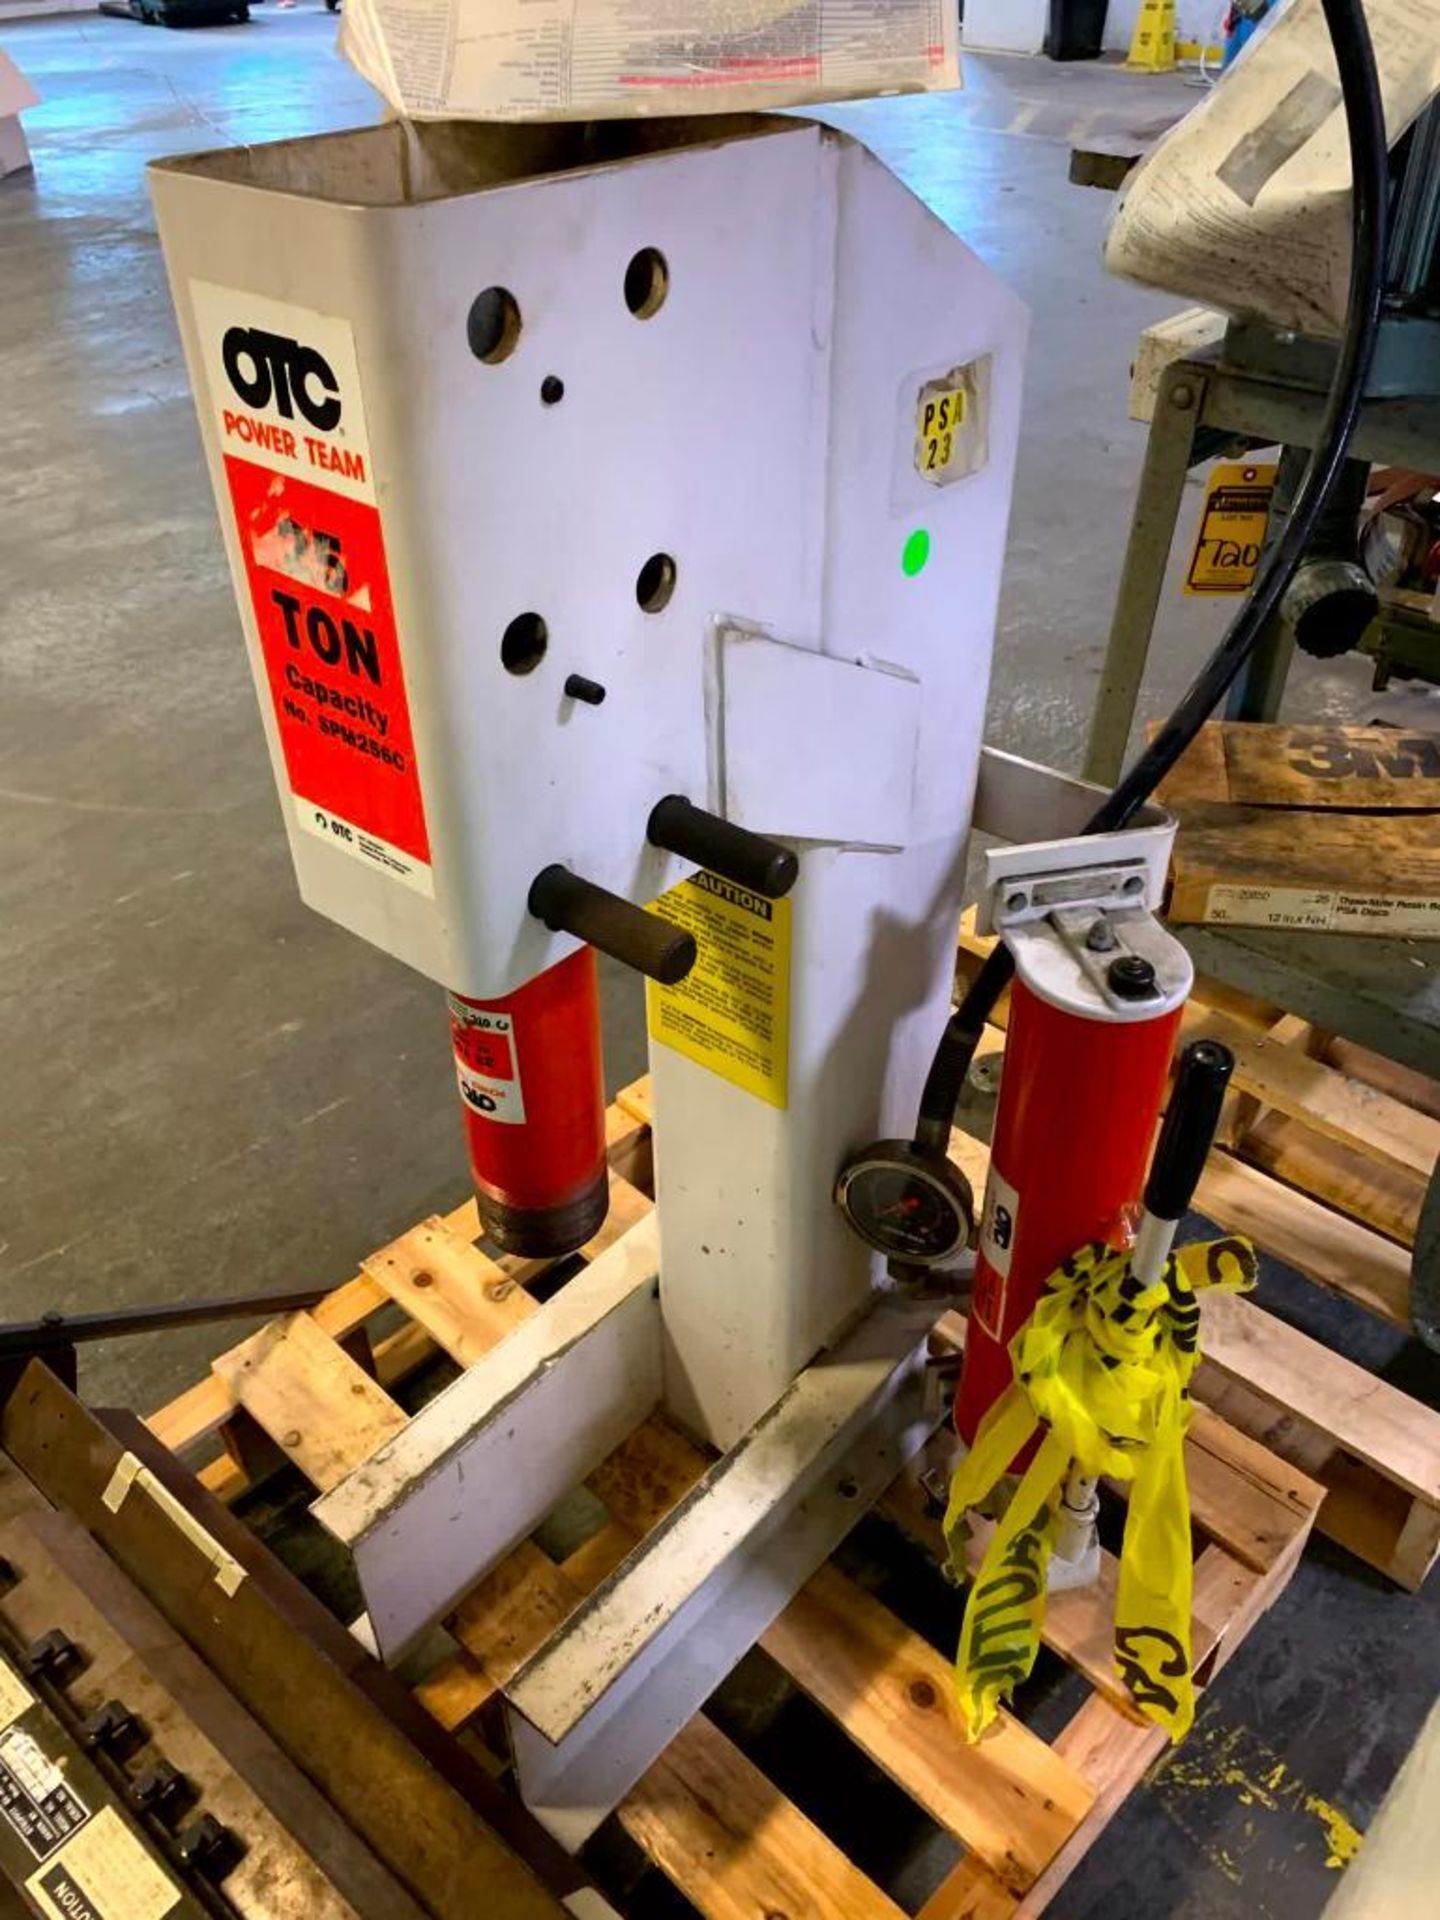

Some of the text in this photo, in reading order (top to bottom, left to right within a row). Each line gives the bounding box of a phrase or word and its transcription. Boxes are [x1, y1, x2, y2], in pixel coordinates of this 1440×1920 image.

[222, 326, 342, 432] OTC
[222, 409, 366, 484] POWER TEAM
[272, 588, 382, 688] TON
[283, 695, 310, 725] No.
[286, 662, 388, 737] Capacity
[993, 1205, 1012, 1250] OTC
[54, 1880, 92, 1920] UTION
